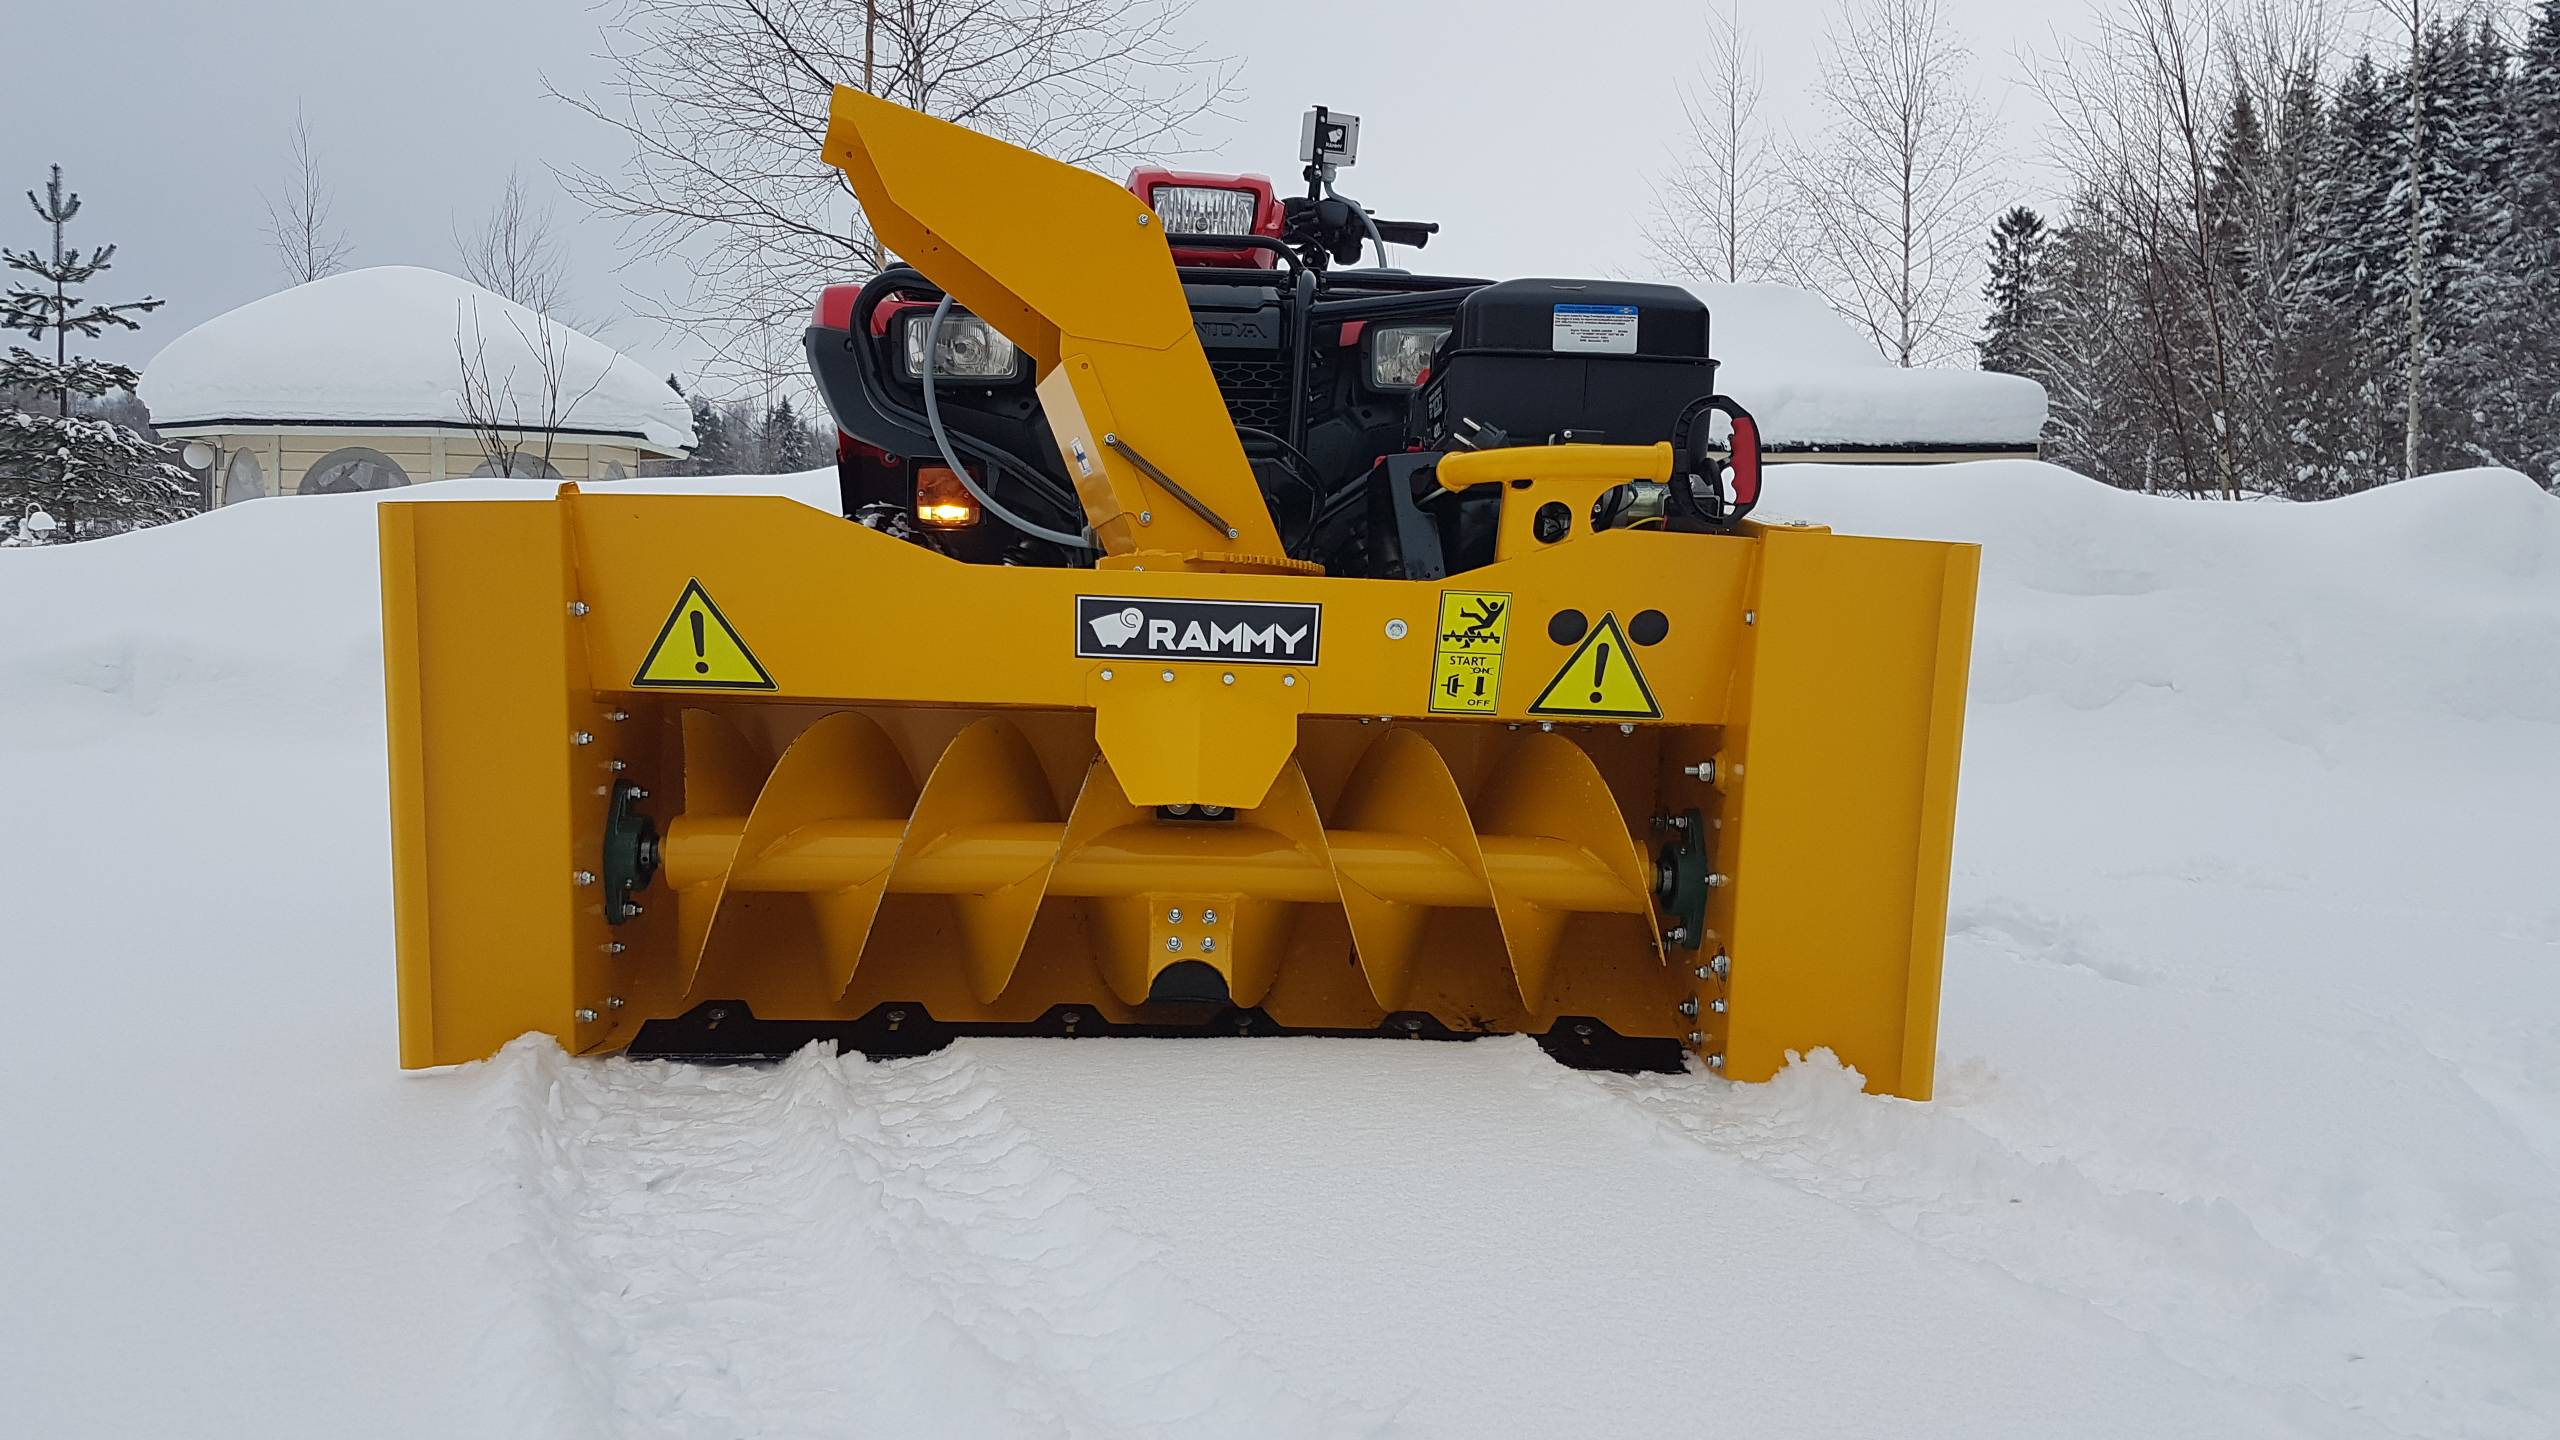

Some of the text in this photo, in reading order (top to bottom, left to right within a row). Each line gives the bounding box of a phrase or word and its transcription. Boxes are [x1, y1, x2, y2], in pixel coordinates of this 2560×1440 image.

[1193, 321, 1266, 338] NDA
[1148, 619, 1307, 654] RAMMY
[1450, 656, 1486, 666] START
